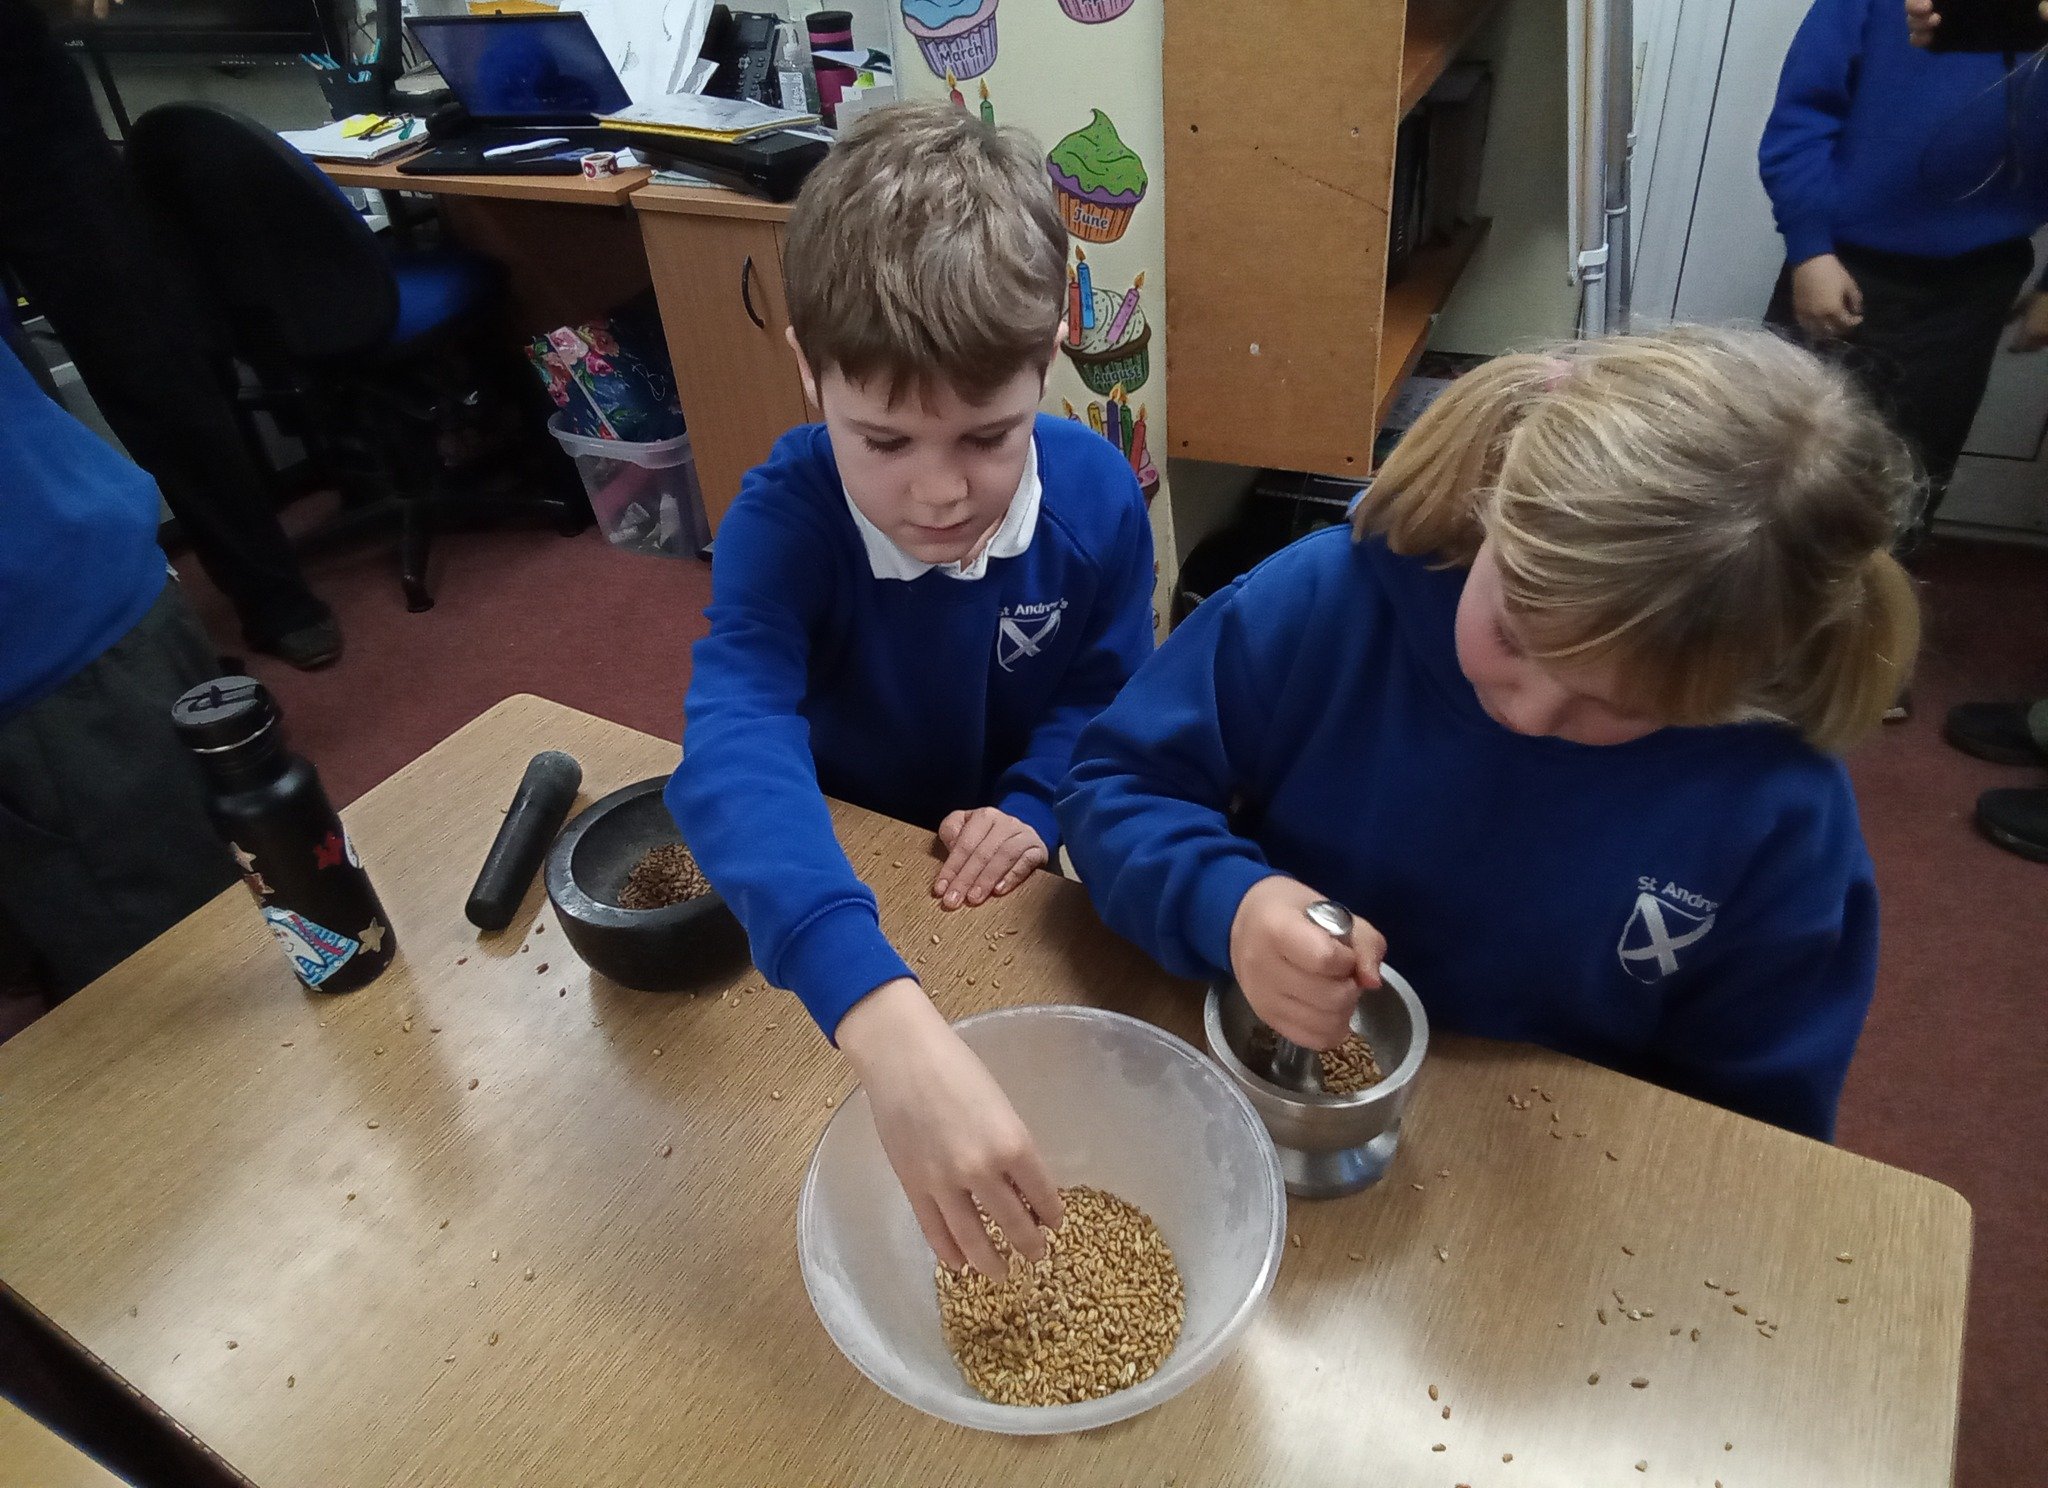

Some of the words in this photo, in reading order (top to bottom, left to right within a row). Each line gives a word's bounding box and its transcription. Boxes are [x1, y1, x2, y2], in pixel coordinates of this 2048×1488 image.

[940, 42, 984, 66] March
[1073, 208, 1108, 229] June
[1095, 366, 1141, 384] August
[1638, 876, 1657, 891] St
